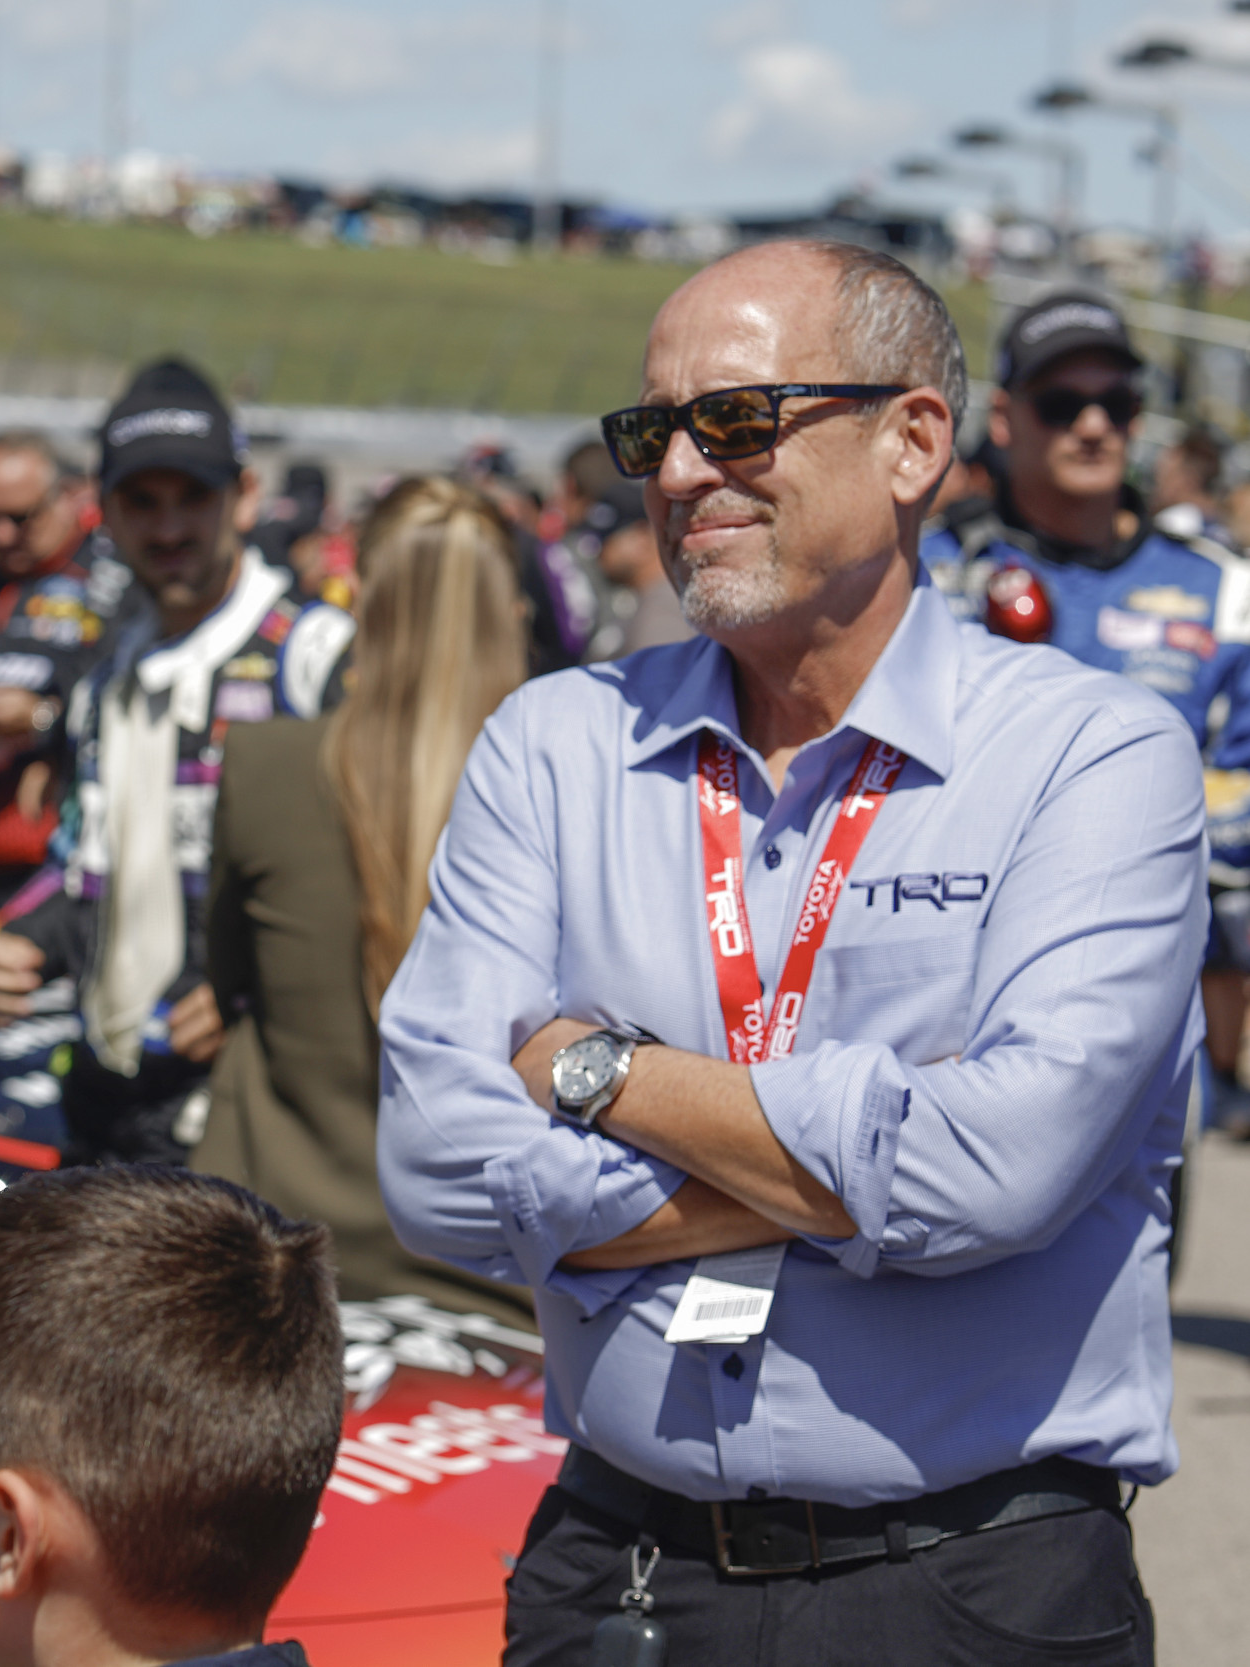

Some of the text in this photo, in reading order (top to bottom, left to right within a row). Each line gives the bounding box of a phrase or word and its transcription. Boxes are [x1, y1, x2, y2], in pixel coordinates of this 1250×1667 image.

[706, 856, 745, 958] TRD
[793, 859, 838, 946] TOYOTA
[850, 872, 989, 913] TRD
[769, 990, 804, 1059] RD
